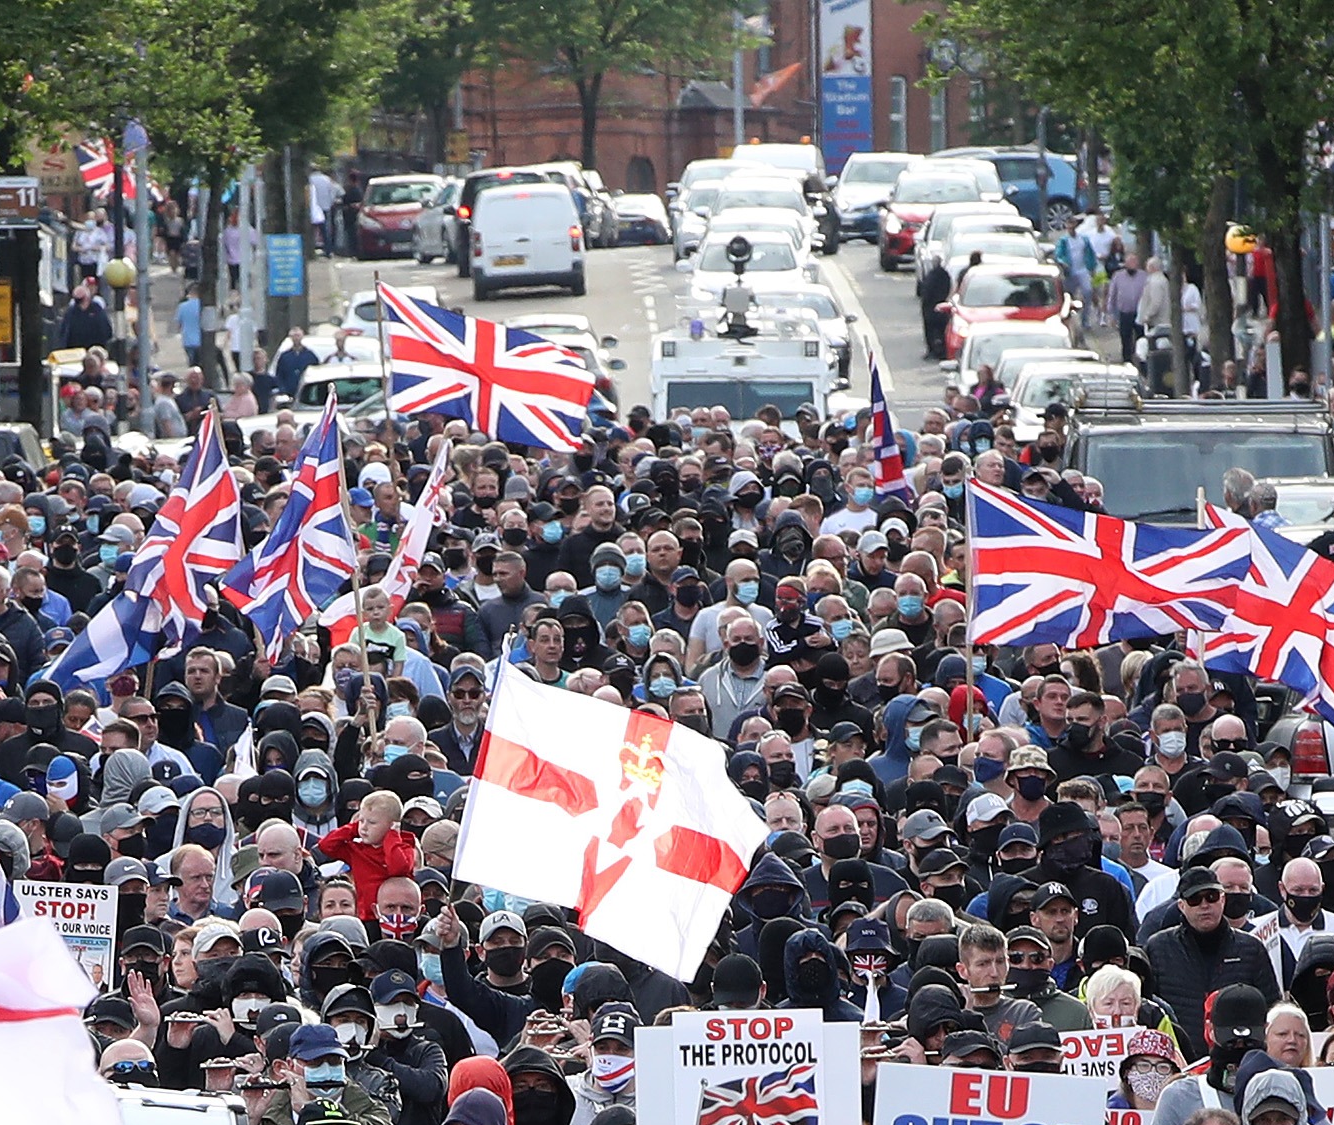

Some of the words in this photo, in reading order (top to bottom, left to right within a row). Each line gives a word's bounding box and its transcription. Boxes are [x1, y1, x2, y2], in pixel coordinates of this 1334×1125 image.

[17, 188, 36, 206] 11
[21, 885, 72, 899] ULSTER
[76, 888, 109, 900] SAYS
[34, 900, 96, 920] STOP!
[62, 922, 81, 934] OUR
[84, 924, 111, 935] VOICE
[706, 1017, 793, 1041] STOP
[679, 1044, 715, 1066] THE
[721, 1042, 817, 1066] PROTOCOL
[1061, 1034, 1125, 1059] EAC
[1081, 1061, 1115, 1076] SAVE
[950, 1072, 1030, 1120] EU
